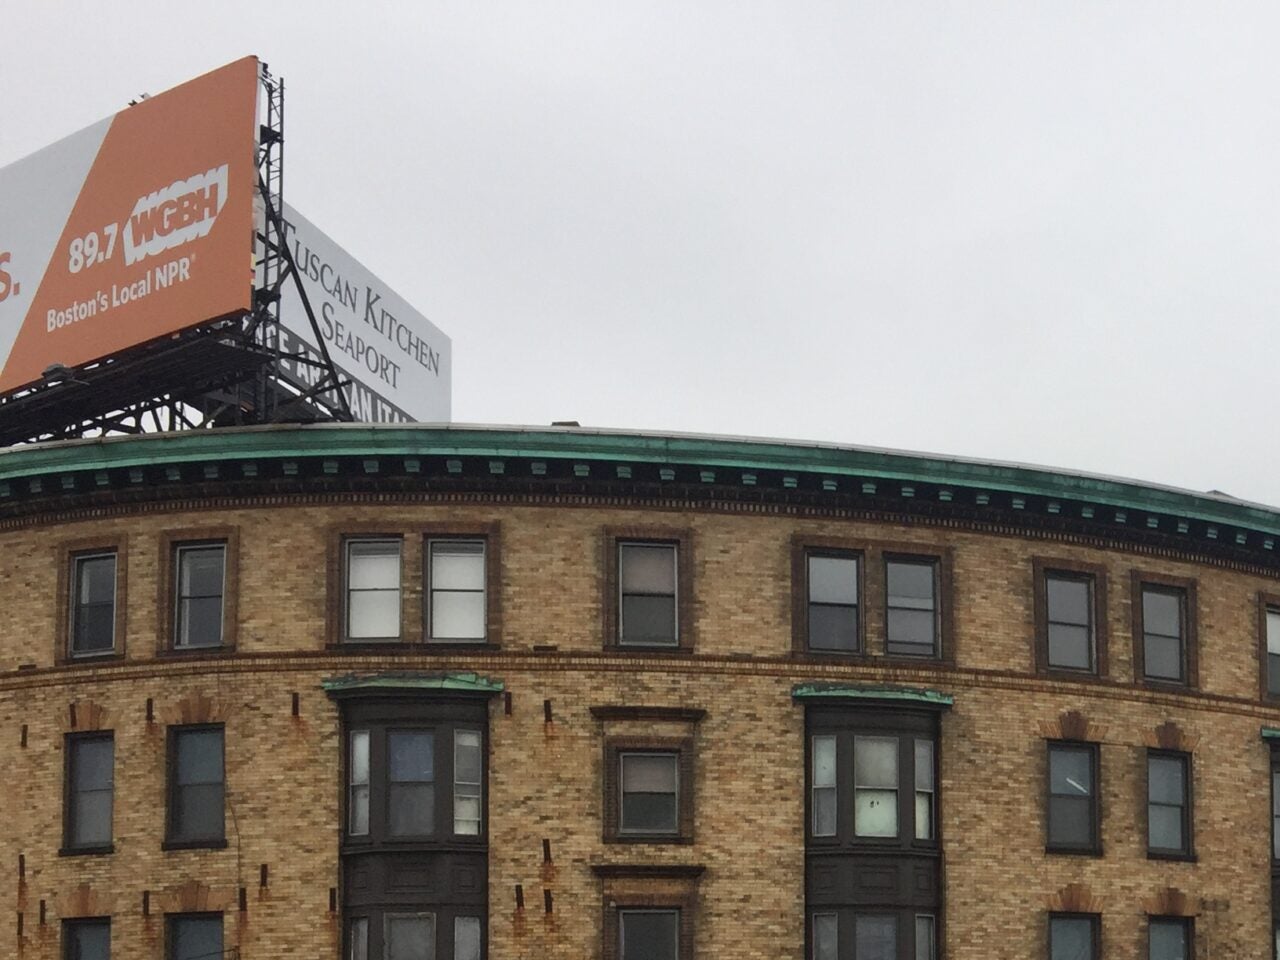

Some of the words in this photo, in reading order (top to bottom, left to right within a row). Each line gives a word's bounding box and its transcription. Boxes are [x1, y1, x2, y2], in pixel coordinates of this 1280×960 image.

[68, 222, 119, 274] 89.7
[126, 174, 225, 258] WGBH
[46, 291, 108, 333] Boston's
[111, 270, 151, 308] Local
[321, 301, 401, 389] SEAPORT
[363, 286, 440, 377] KITCHEN
